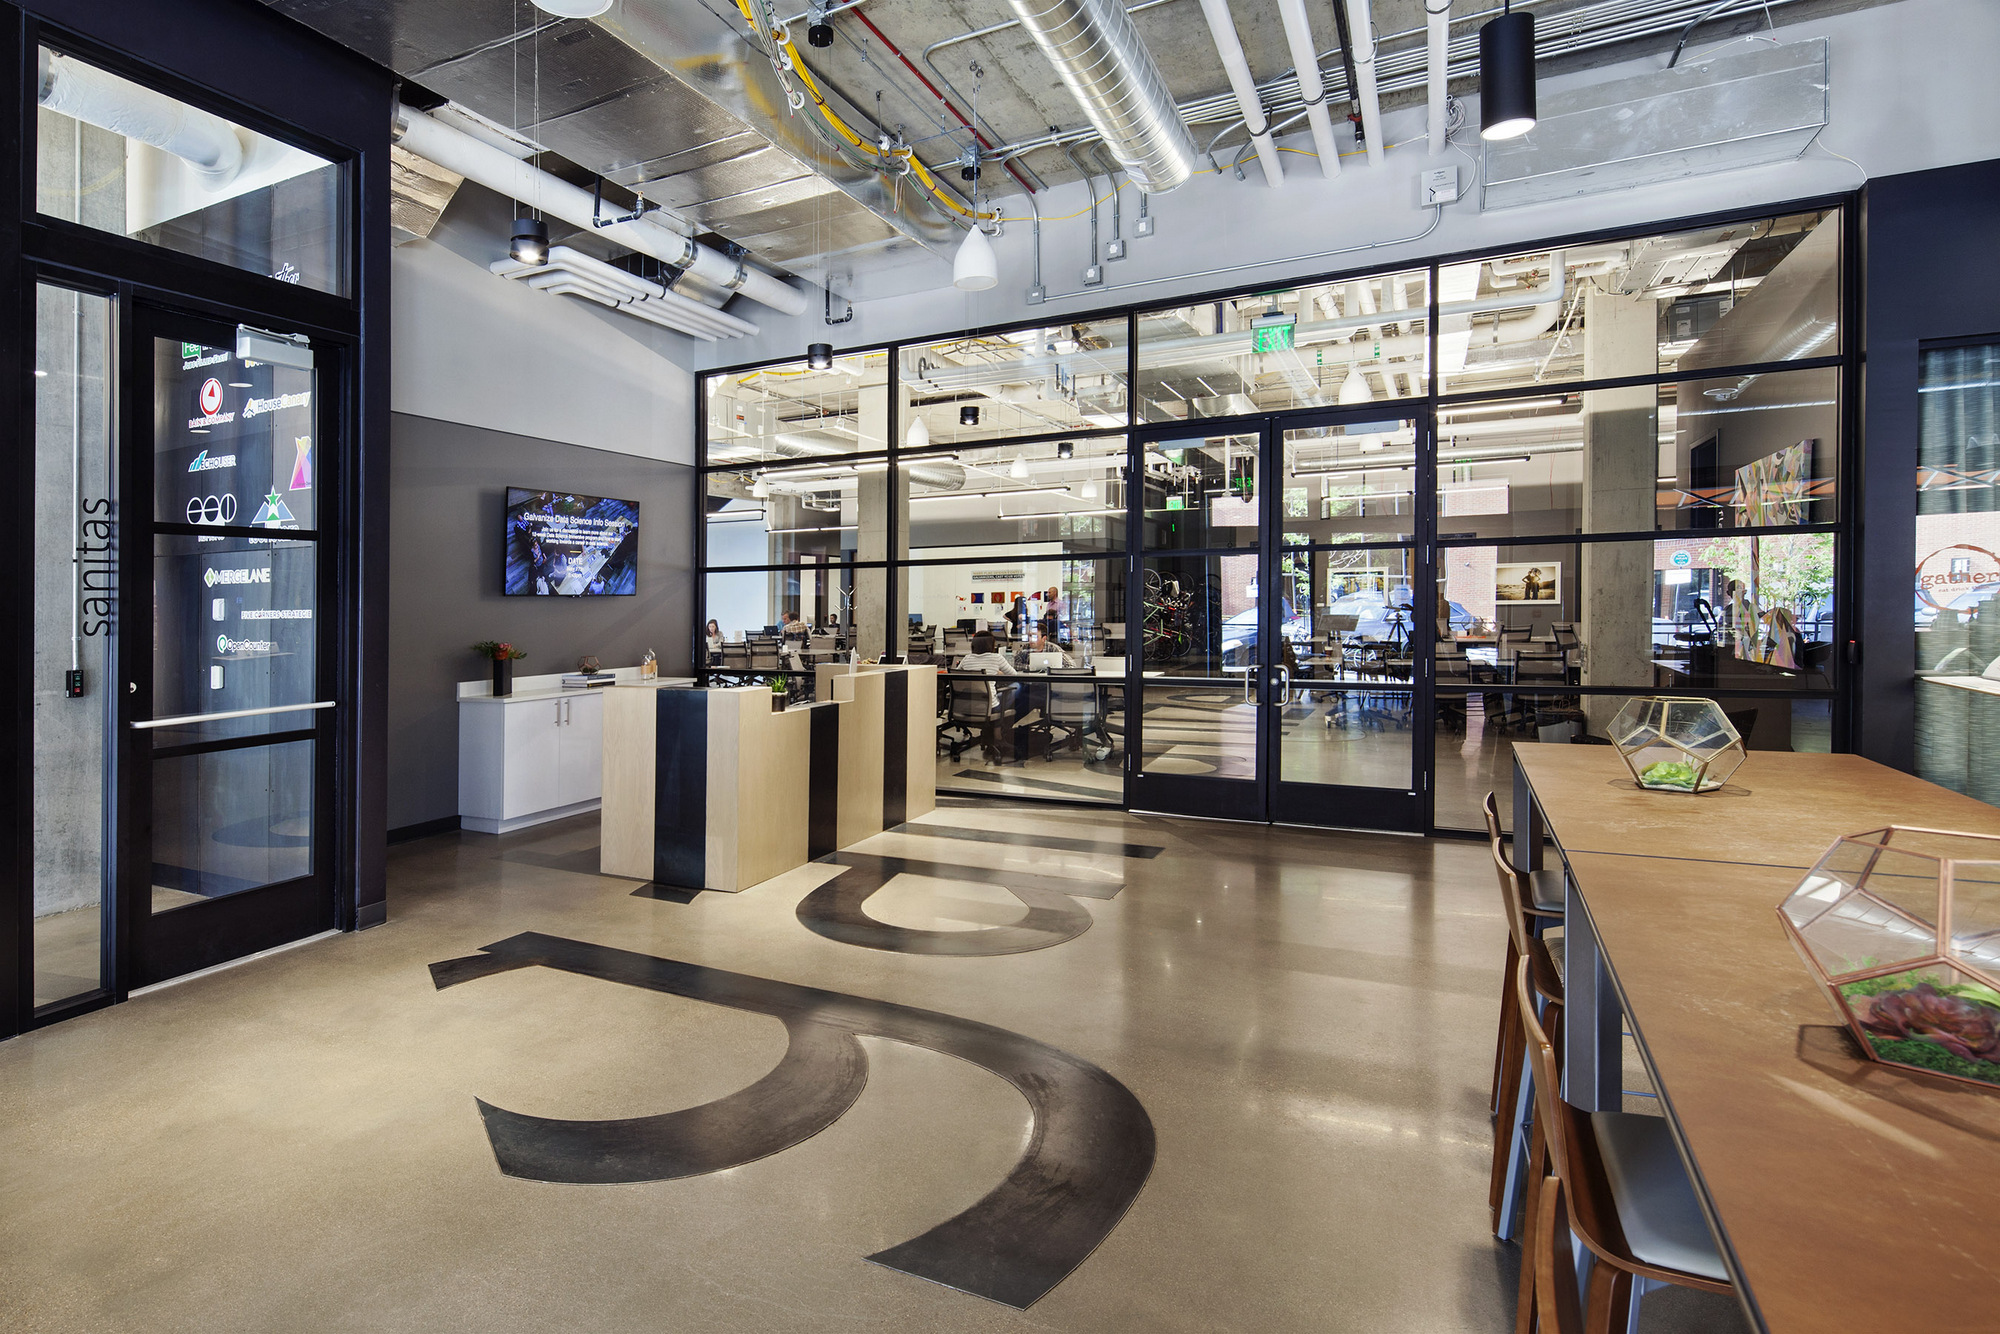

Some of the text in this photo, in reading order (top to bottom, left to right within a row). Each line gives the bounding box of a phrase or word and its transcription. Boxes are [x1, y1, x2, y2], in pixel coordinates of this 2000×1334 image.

[1259, 326, 1291, 352] EXIT
[257, 391, 311, 414] HouseCanary
[207, 412, 235, 425] COMPANY
[523, 512, 554, 522] Galvanize
[570, 516, 592, 526] Science
[73, 498, 110, 637] sanitas
[215, 568, 271, 584] MERGELANE
[1921, 570, 1999, 590] gather
[280, 609, 312, 619] STRATEGIE
[226, 639, 271, 653] OpenCounter
